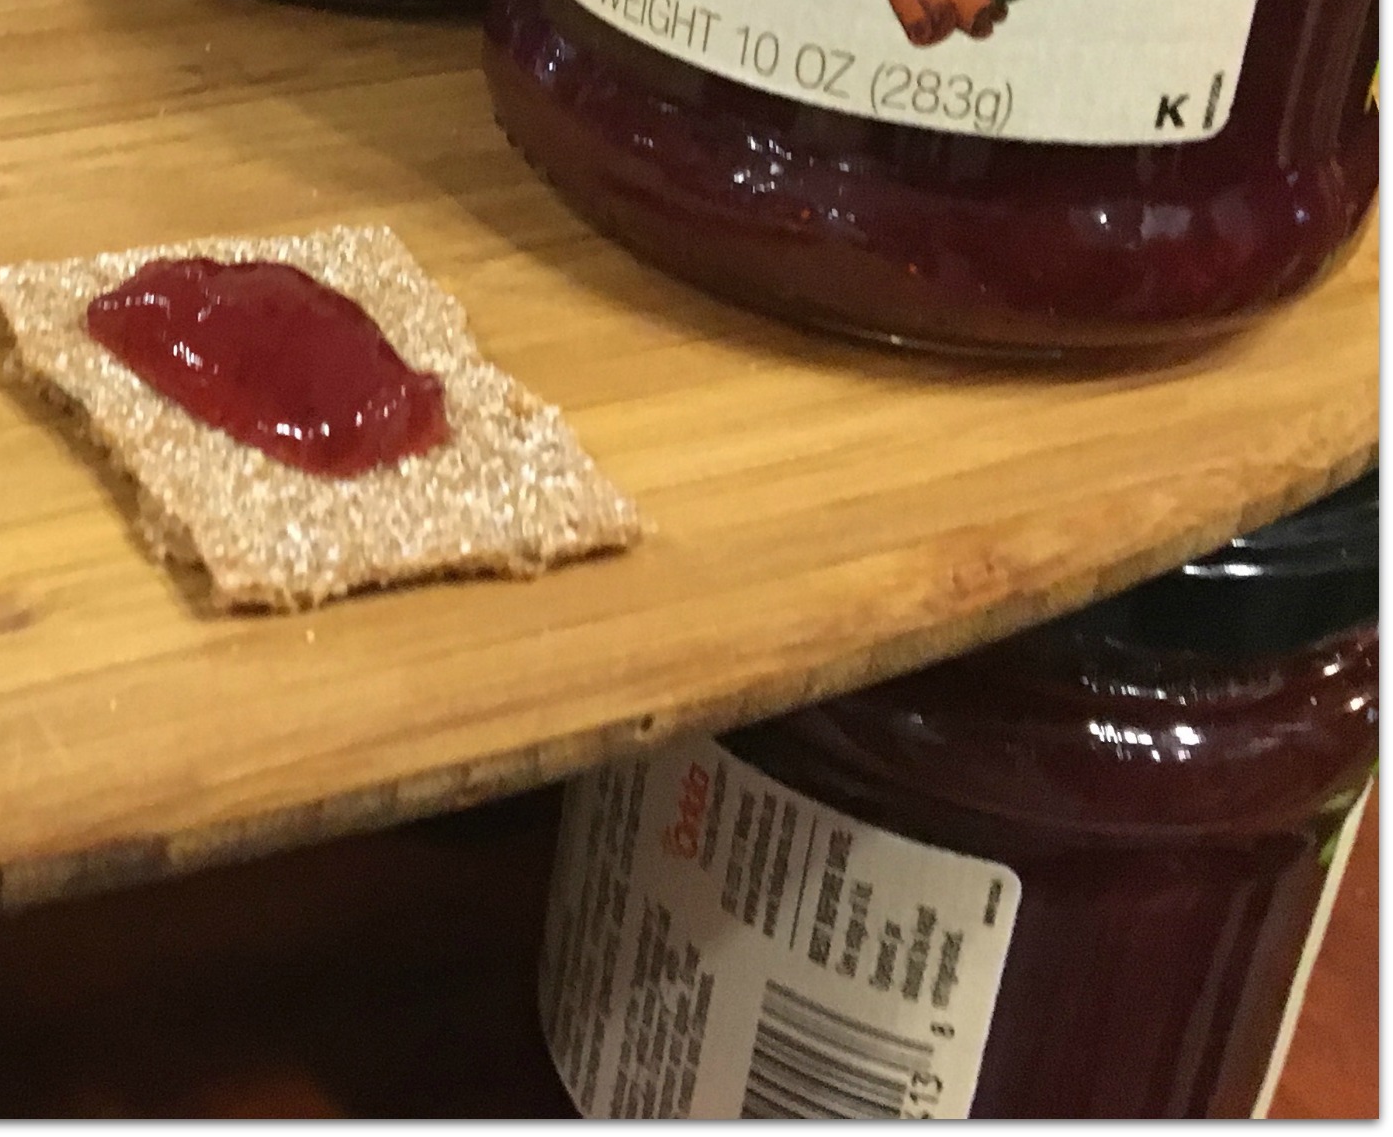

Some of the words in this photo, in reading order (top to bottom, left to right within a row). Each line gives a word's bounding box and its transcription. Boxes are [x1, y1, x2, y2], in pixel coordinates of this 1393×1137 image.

[736, 25, 780, 77] 10
[794, 44, 857, 100] OZ
[870, 62, 1014, 135] (283g)
[1154, 92, 1189, 130] K
